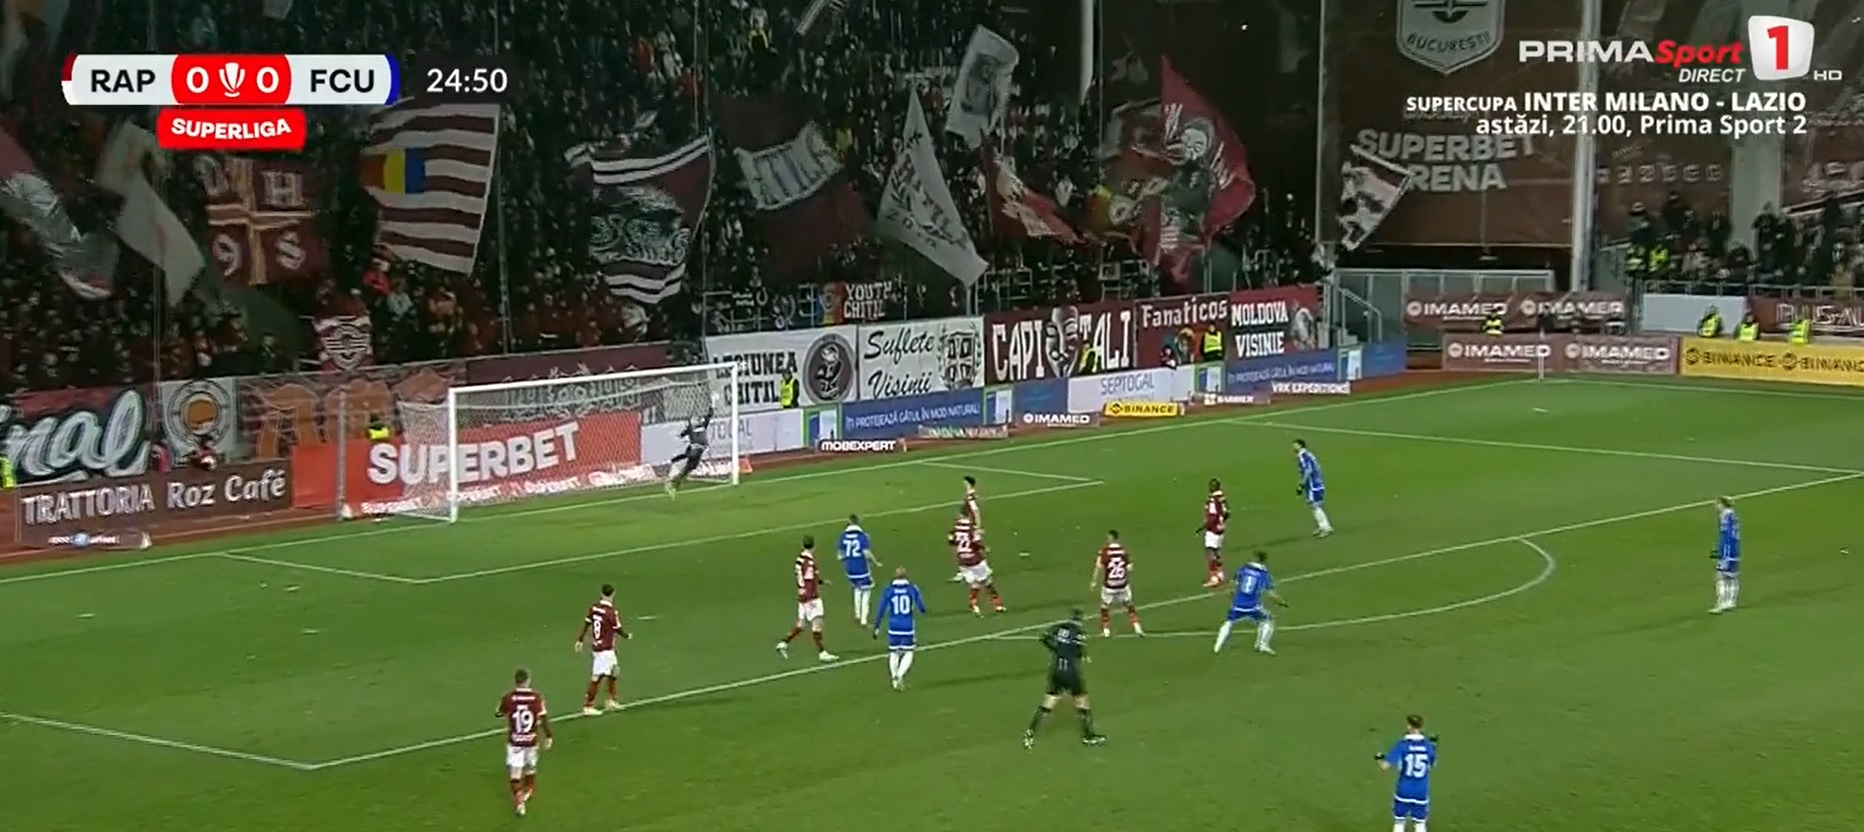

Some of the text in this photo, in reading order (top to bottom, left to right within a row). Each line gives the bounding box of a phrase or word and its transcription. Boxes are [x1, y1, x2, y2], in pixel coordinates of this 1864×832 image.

[1356, 129, 1535, 161] SUPERBET
[1407, 163, 1508, 192] RENA
[1141, 296, 1229, 328] Fanaticos
[1231, 300, 1289, 326] MOLDOVA
[863, 331, 935, 364] Suflete
[1235, 330, 1285, 358] VISINIE
[1465, 343, 1551, 358] IMAMED
[1580, 344, 1671, 360] IMAMED
[1703, 352, 1778, 369] BINANCE
[1101, 372, 1155, 395] SEPTOGAL
[1035, 413, 1091, 424] IMAMED
[1124, 403, 1174, 414] BINANCE
[367, 422, 579, 485] SUPERBET
[821, 440, 897, 452] MOBEXPERT
[20, 468, 287, 525] TRATTORIA Roz Café
[843, 538, 861, 558] 72
[1108, 560, 1126, 579] 26
[891, 594, 911, 615] 10
[512, 709, 535, 734] 19
[1404, 753, 1429, 778] 15
